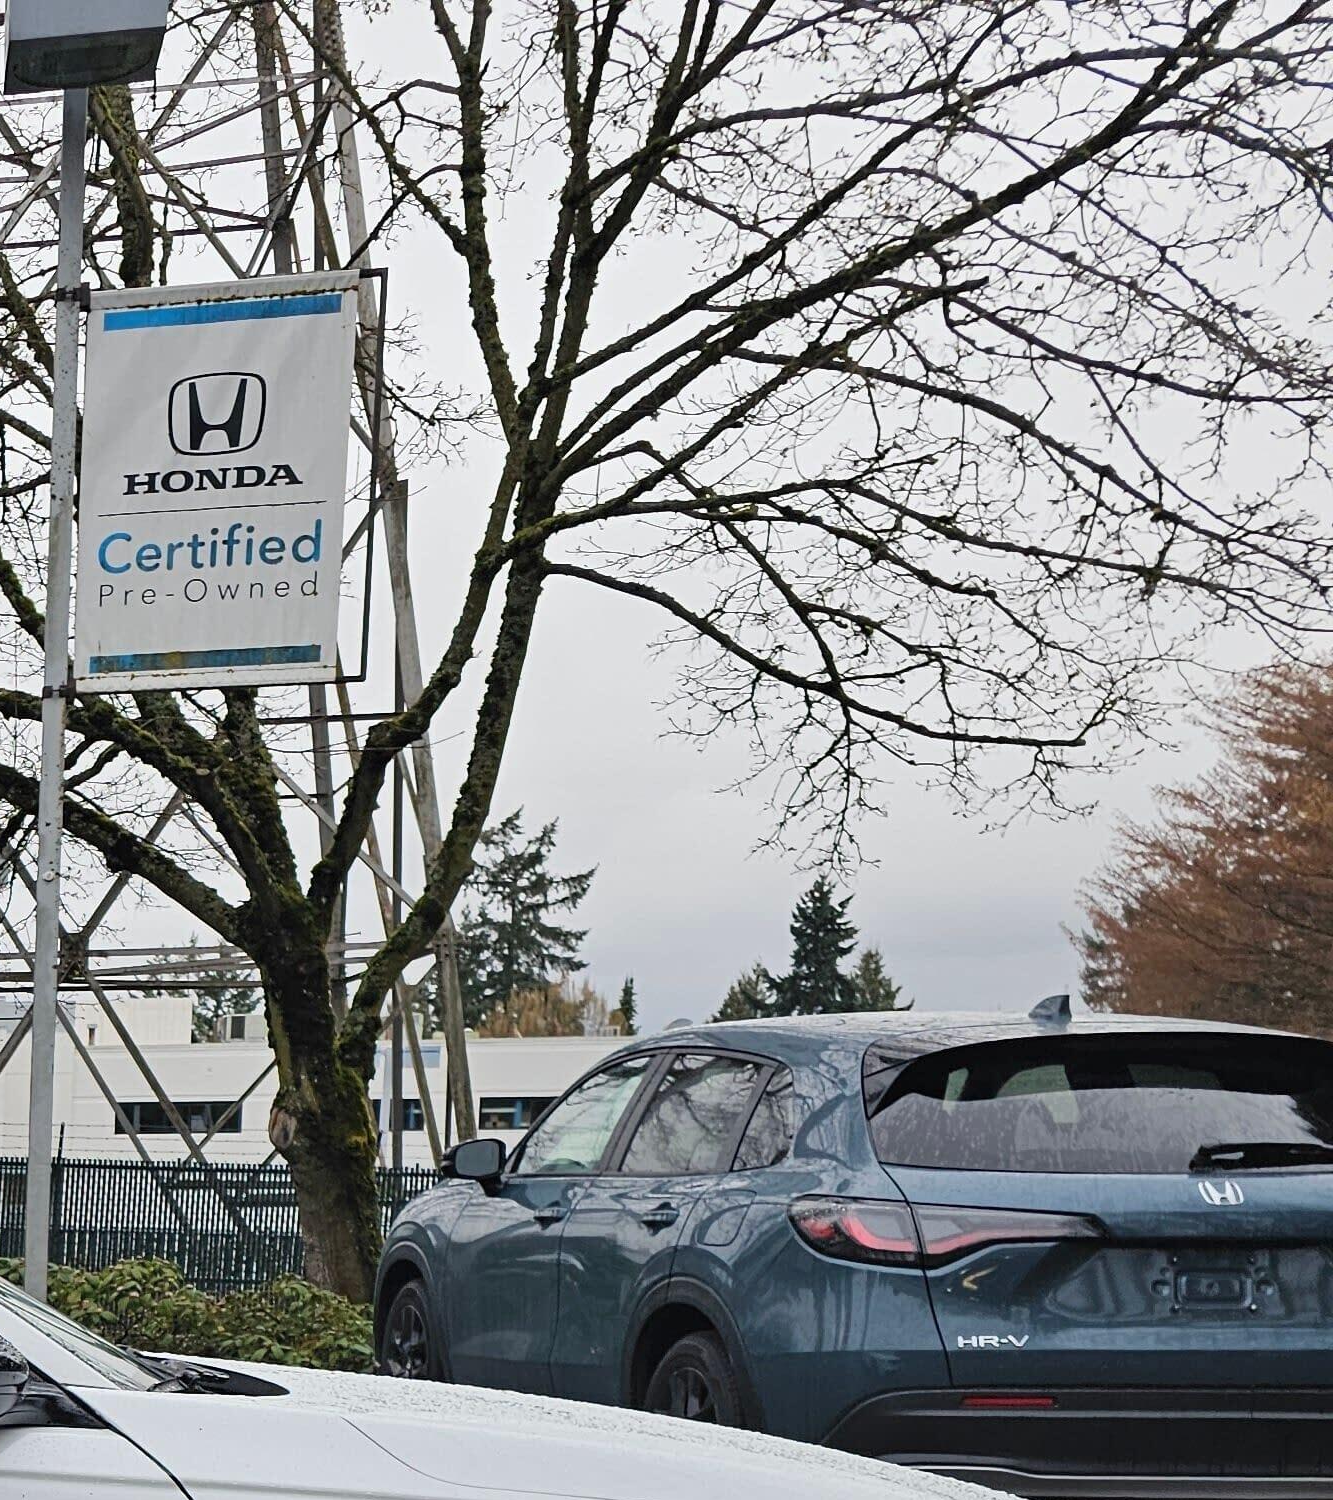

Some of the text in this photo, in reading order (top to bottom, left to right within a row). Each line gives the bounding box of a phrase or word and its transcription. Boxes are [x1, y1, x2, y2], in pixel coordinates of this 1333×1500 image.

[123, 464, 303, 495] HONDA
[98, 519, 322, 574] Certified
[99, 570, 318, 607] Pre-Owned
[957, 1334, 1030, 1348] HR-V
